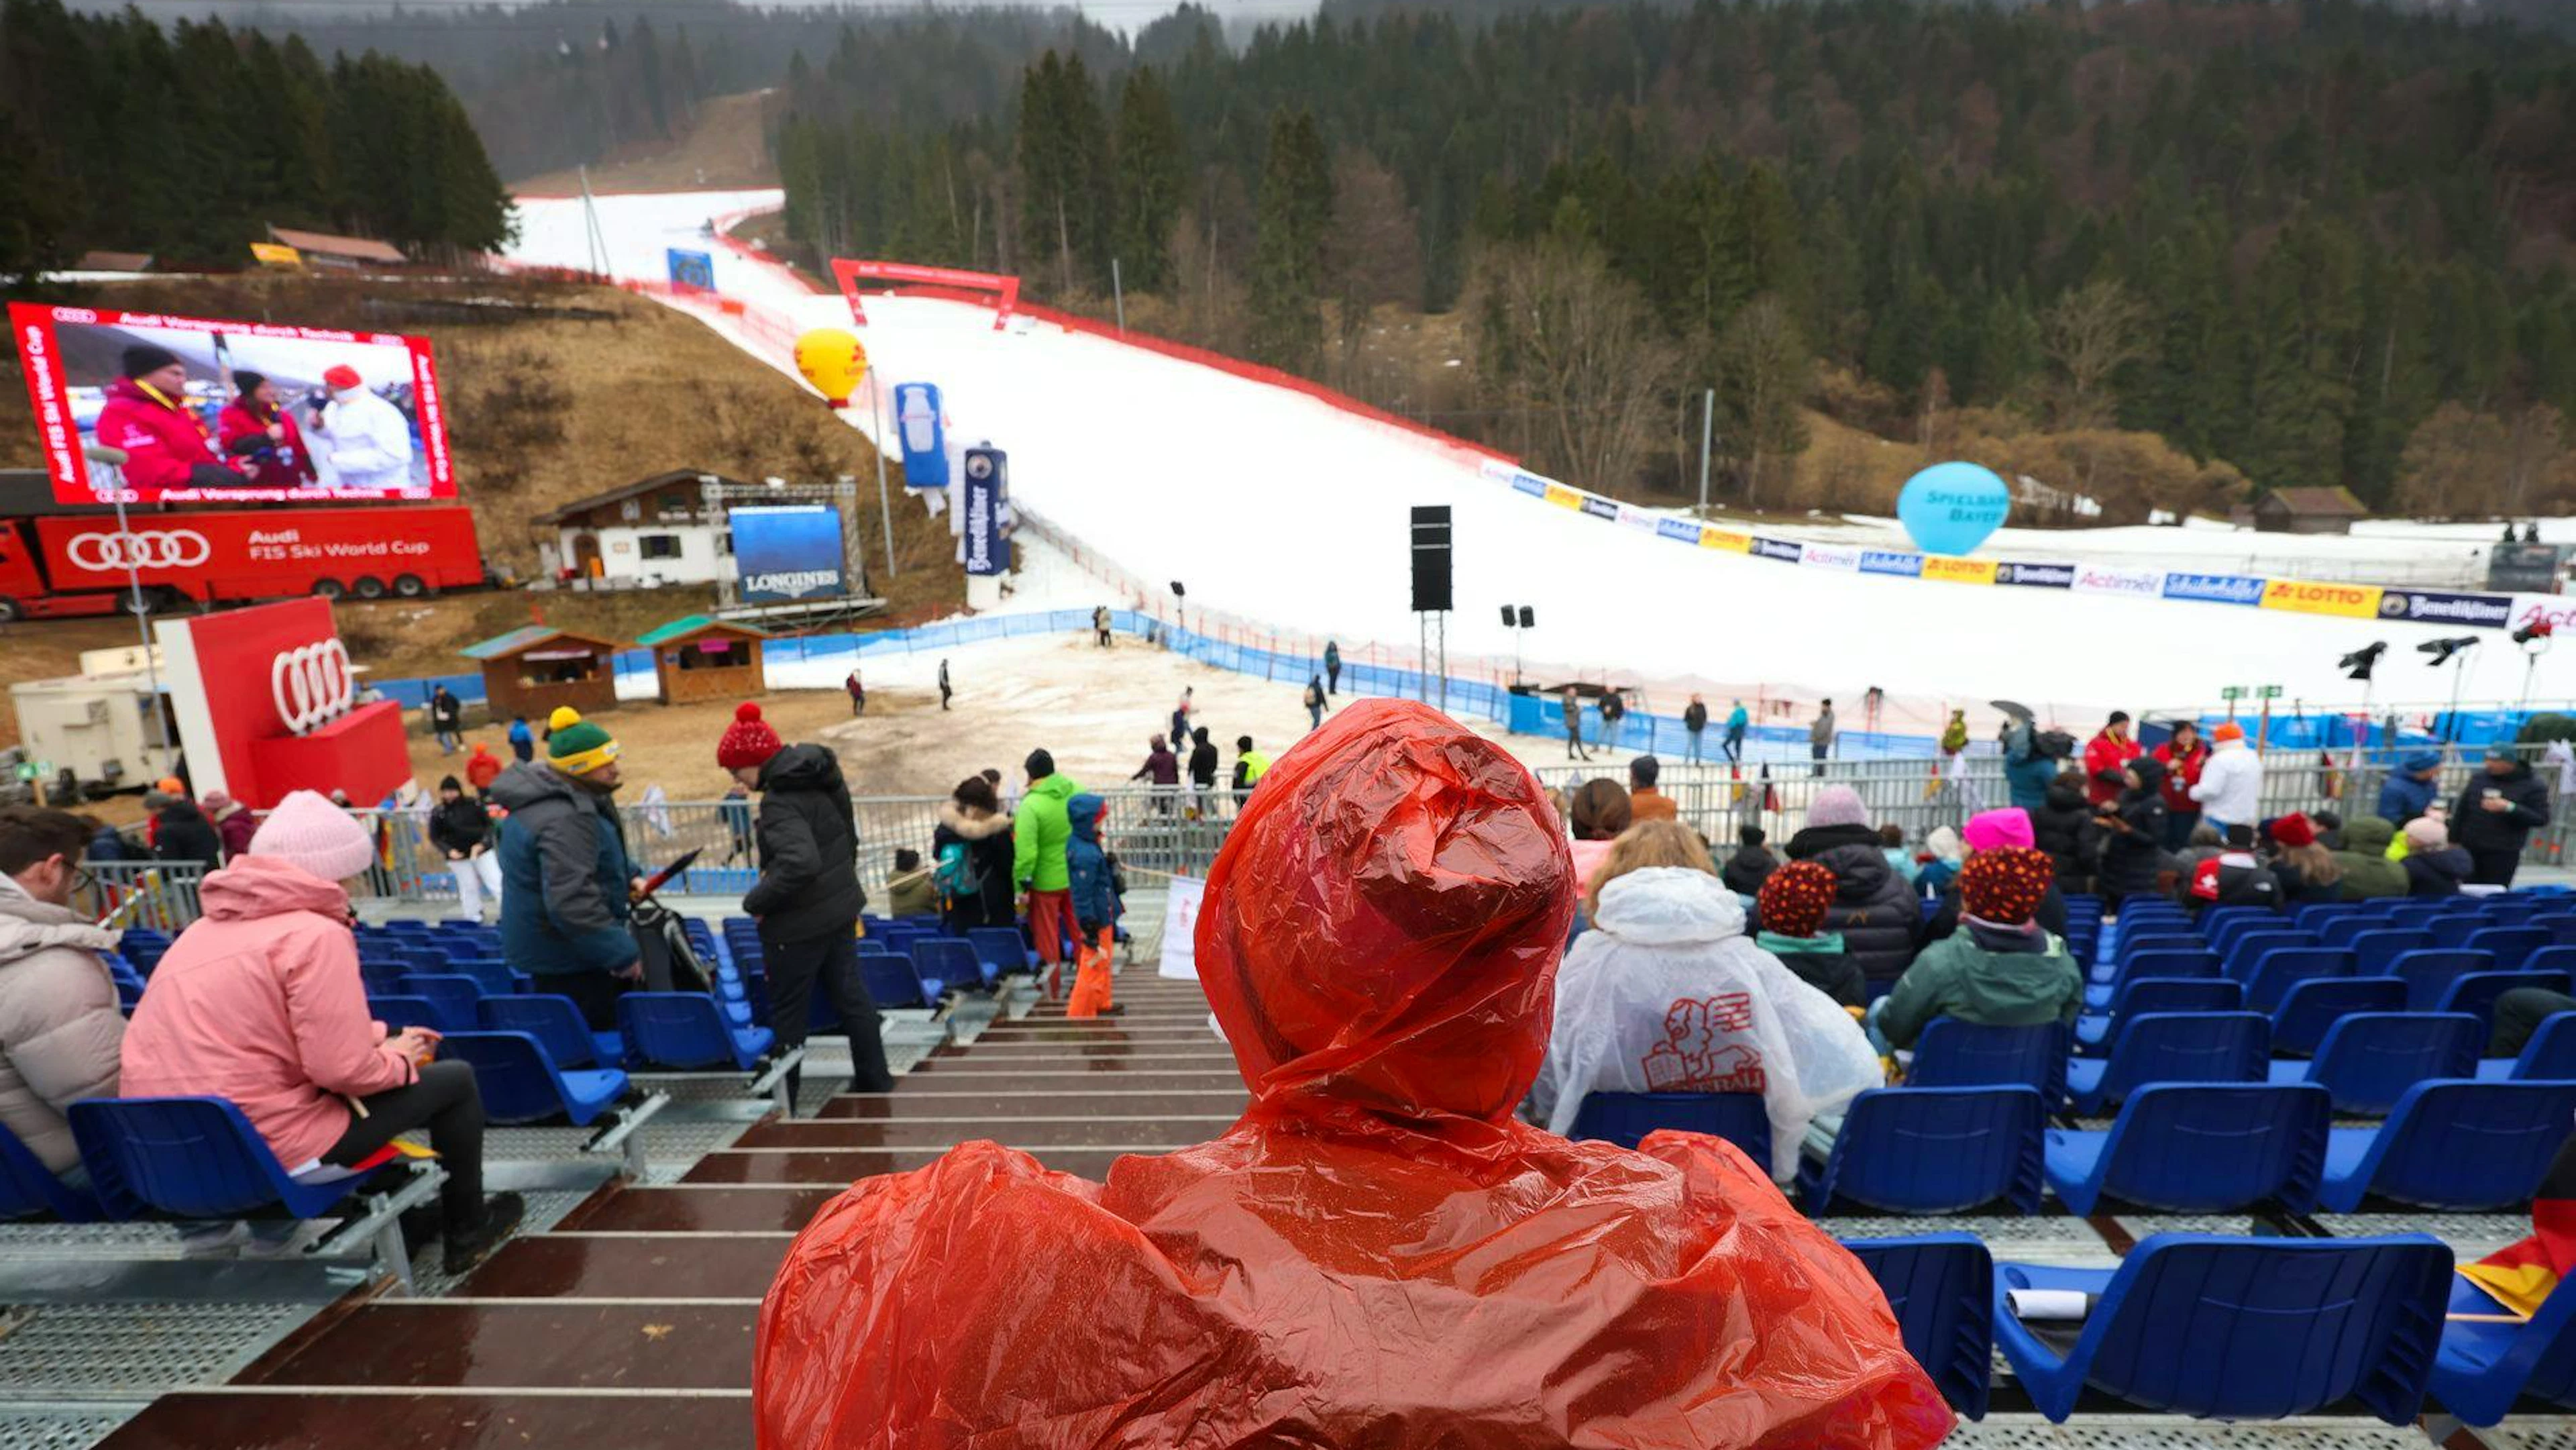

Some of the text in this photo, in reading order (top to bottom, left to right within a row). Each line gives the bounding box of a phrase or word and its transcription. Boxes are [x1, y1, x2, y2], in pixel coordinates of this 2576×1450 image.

[248, 528, 300, 544] Audi
[249, 539, 431, 560] FIS Ski World Cup
[745, 569, 839, 592] LONGINES
[2298, 586, 2363, 605] LOTTO
